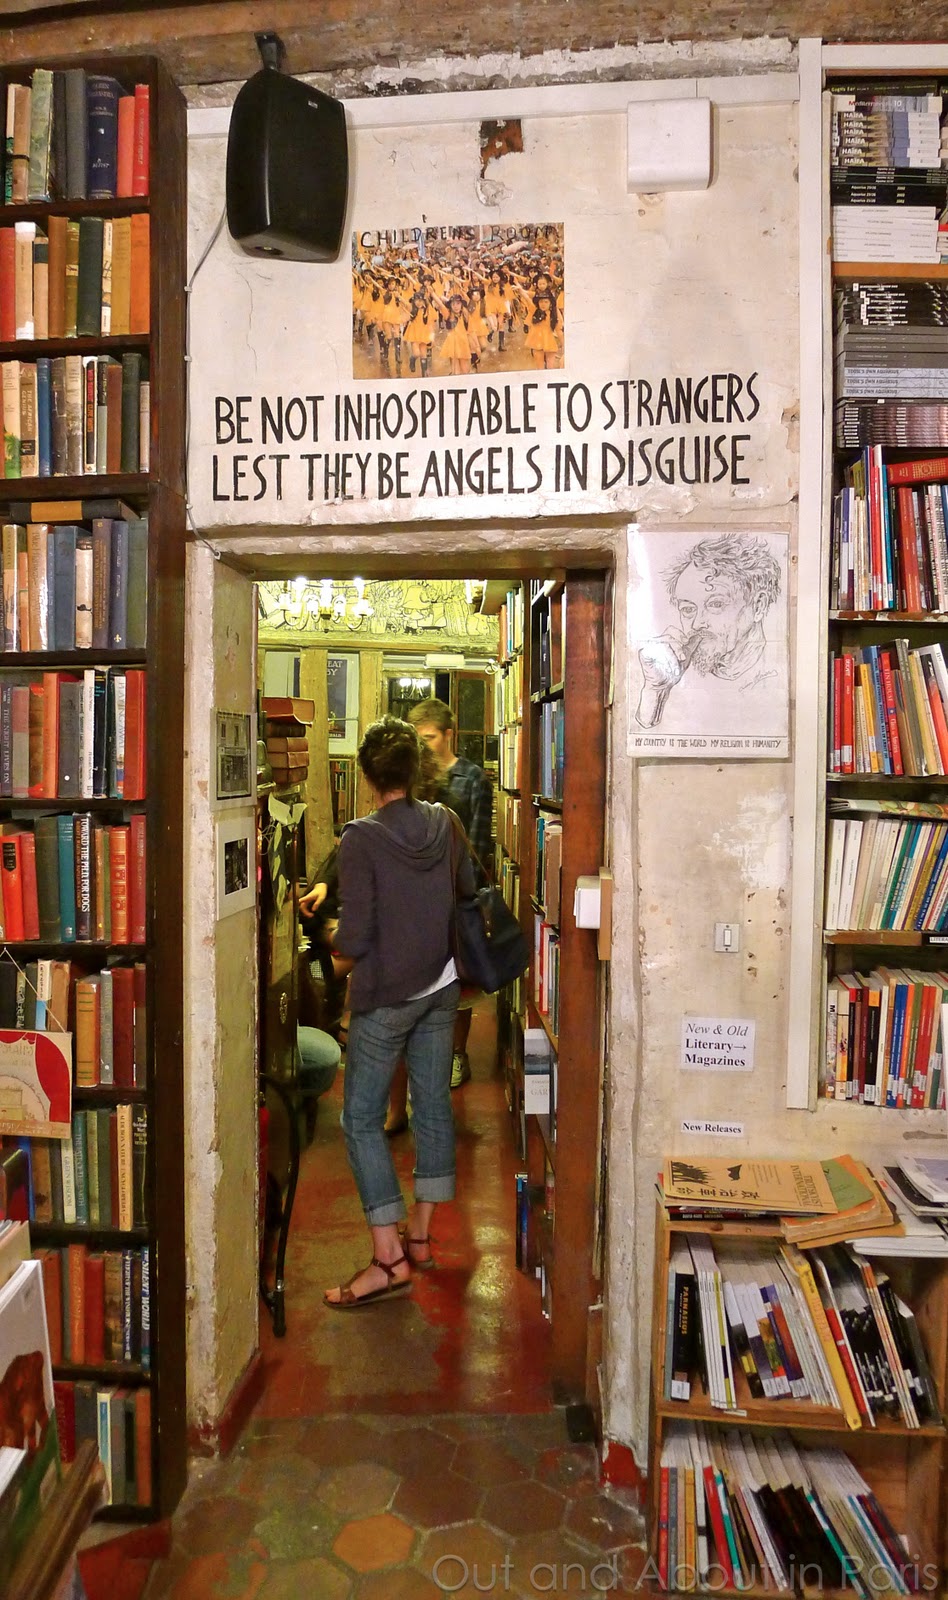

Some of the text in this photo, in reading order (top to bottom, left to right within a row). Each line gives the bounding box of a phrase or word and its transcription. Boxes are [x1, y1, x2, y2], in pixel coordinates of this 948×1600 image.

[360, 224, 560, 248] CHILDRENS ROOM
[215, 371, 760, 445] BE NOT INHOSPITABLE TO STRANGERS
[212, 434, 751, 501] LEST THEY BE ANGELS IN DISGUISE
[635, 738, 781, 748] MY COUNTRY IS THE WORLD MY RELIGION IS HUMANITY
[4, 772, 10, 784] ON
[81, 818, 90, 845] TOWARD
[81, 846, 90, 860] THE
[81, 879, 90, 892] FOR
[81, 894, 90, 912] DOGS
[686, 1023, 749, 1036] New & Old
[686, 1038, 734, 1053] Literary
[684, 1054, 746, 1068] Magazines
[683, 1122, 742, 1134] New Releases
[142, 1261, 150, 1295] SILENT
[142, 1296, 150, 1330] WORLD
